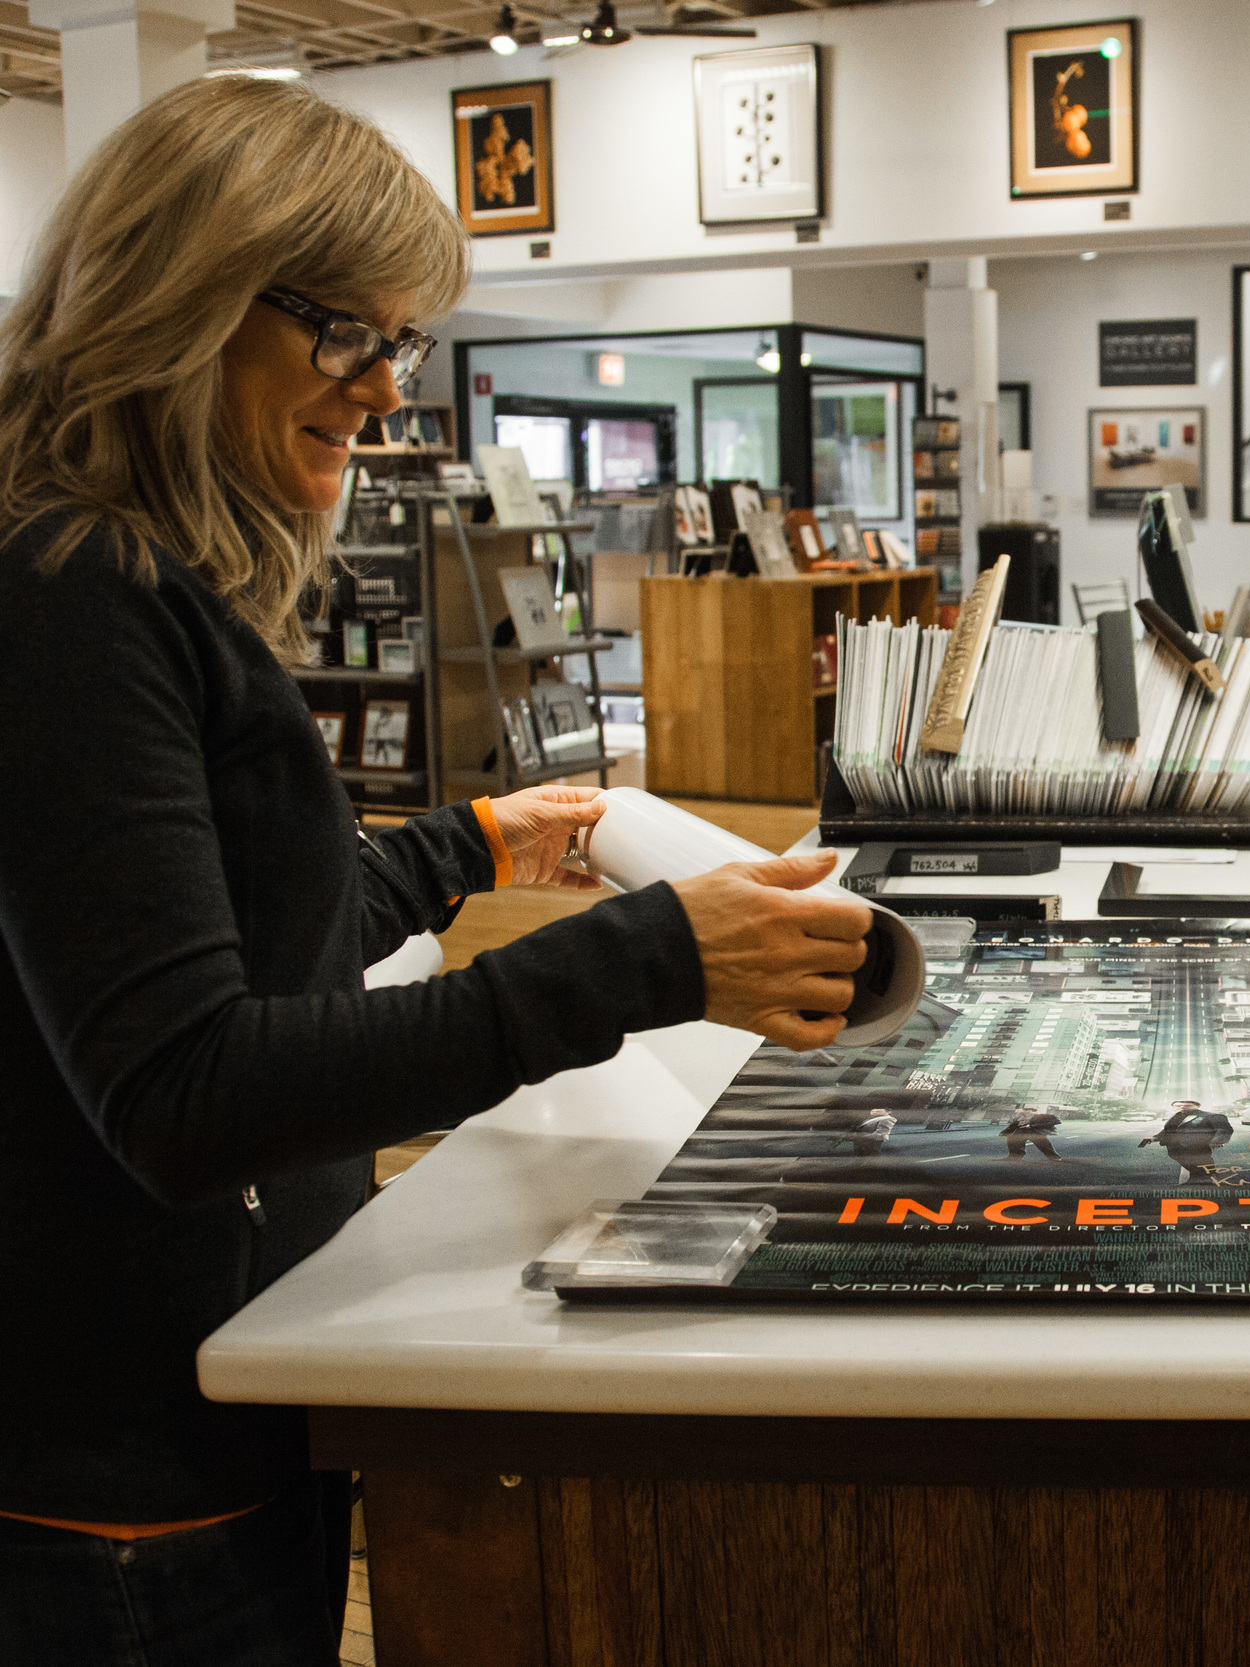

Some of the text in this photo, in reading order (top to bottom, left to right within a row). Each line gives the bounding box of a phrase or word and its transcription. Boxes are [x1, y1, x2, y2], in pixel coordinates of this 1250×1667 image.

[1153, 1189, 1230, 1198] CHRISTOPHER
[1093, 1232, 1147, 1243] WARNER
[985, 1261, 1027, 1272] WALLY
[1159, 1271, 1247, 1282] CHRISTOPHER
[1124, 1284, 1156, 1294] 16
[1166, 1283, 1196, 1293] IN
